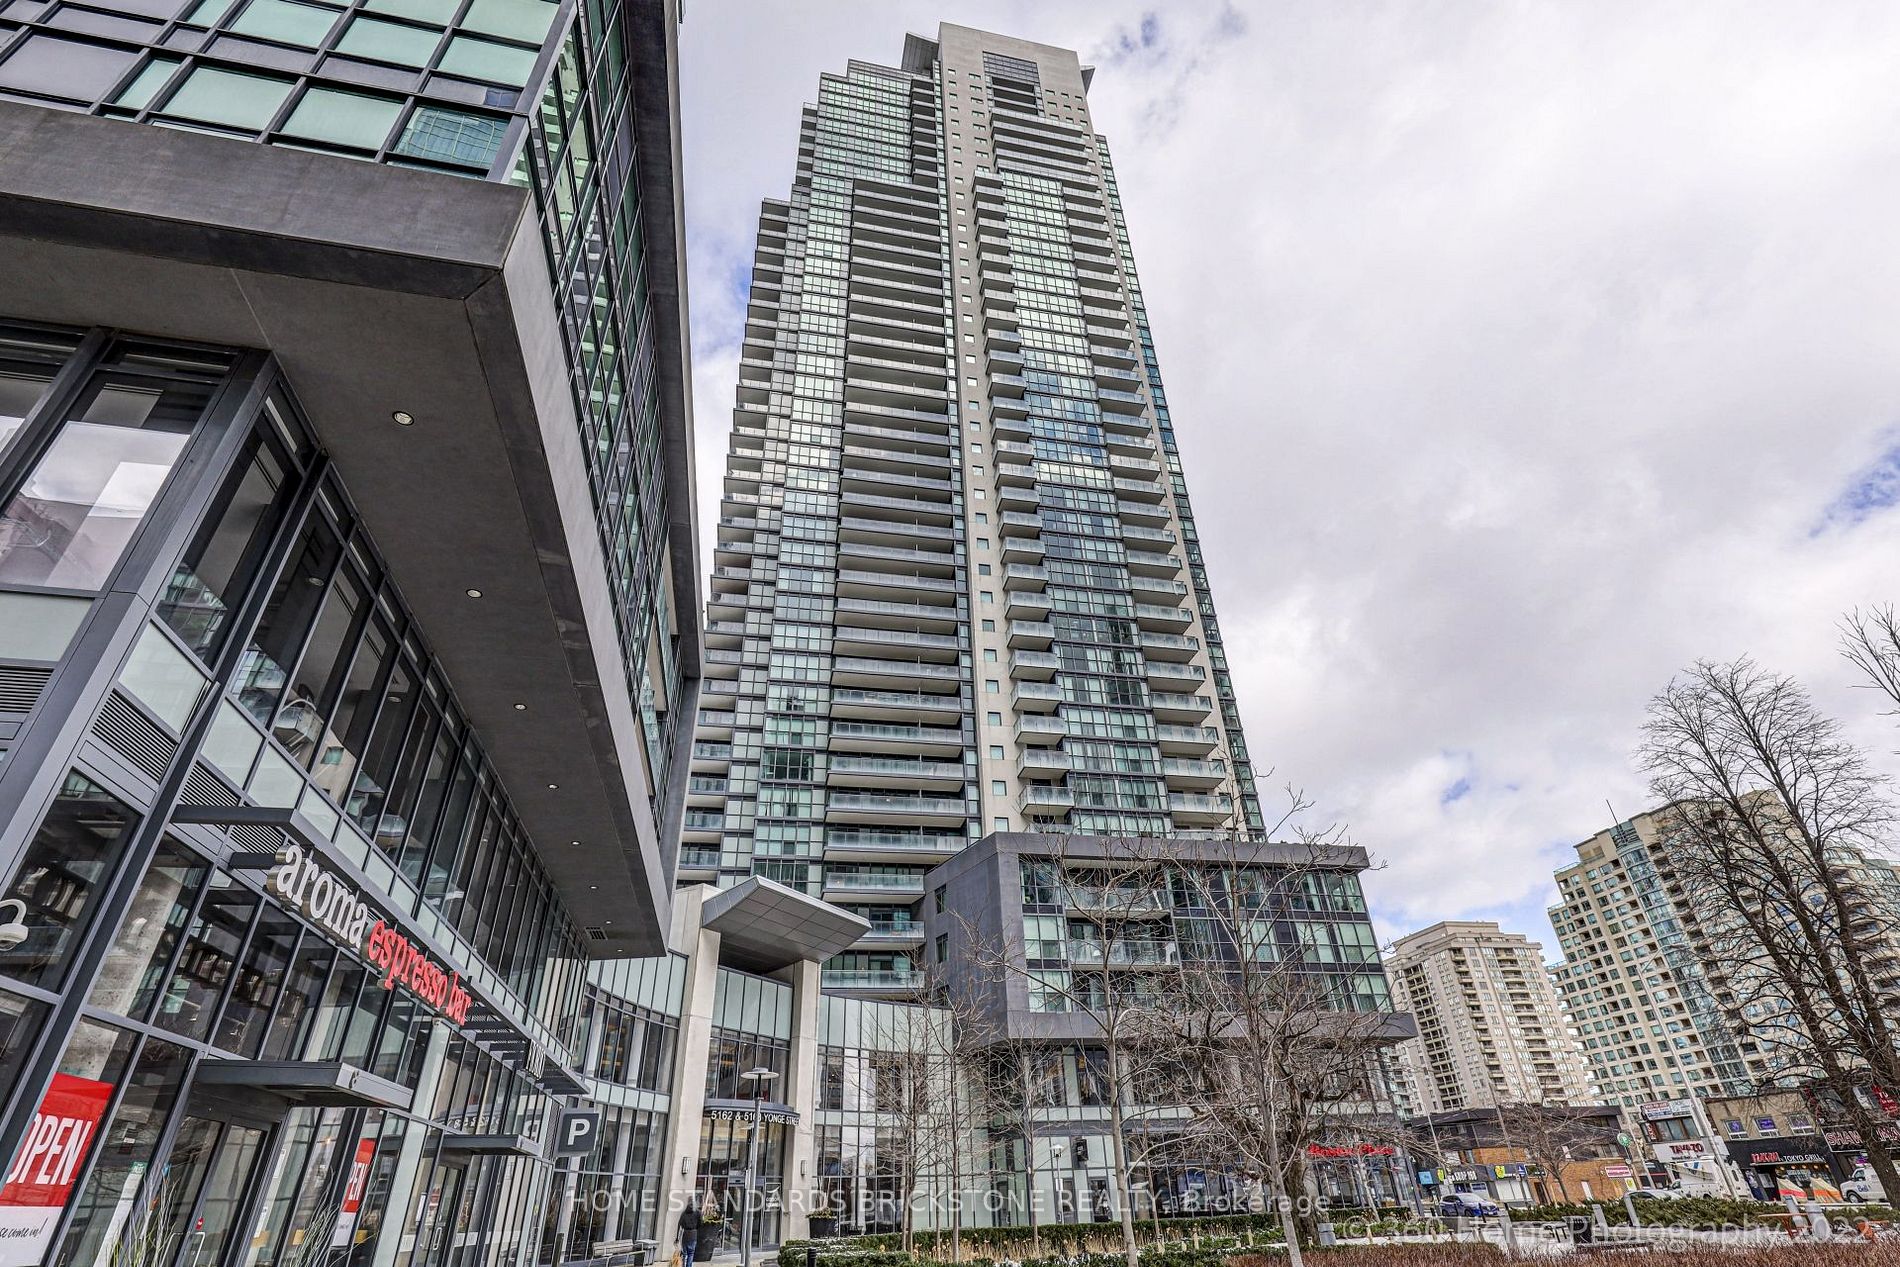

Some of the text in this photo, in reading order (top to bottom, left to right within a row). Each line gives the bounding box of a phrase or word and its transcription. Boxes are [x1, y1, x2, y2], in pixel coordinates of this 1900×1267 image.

[274, 844, 473, 1026] aroma espresso bar
[711, 1110, 733, 1121] 5162
[735, 1111, 742, 1121] &
[763, 1112, 786, 1124] YONGE
[567, 1118, 591, 1146] P
[1783, 1154, 1804, 1163] TOKYO
[1804, 1154, 1824, 1163] GRILL
